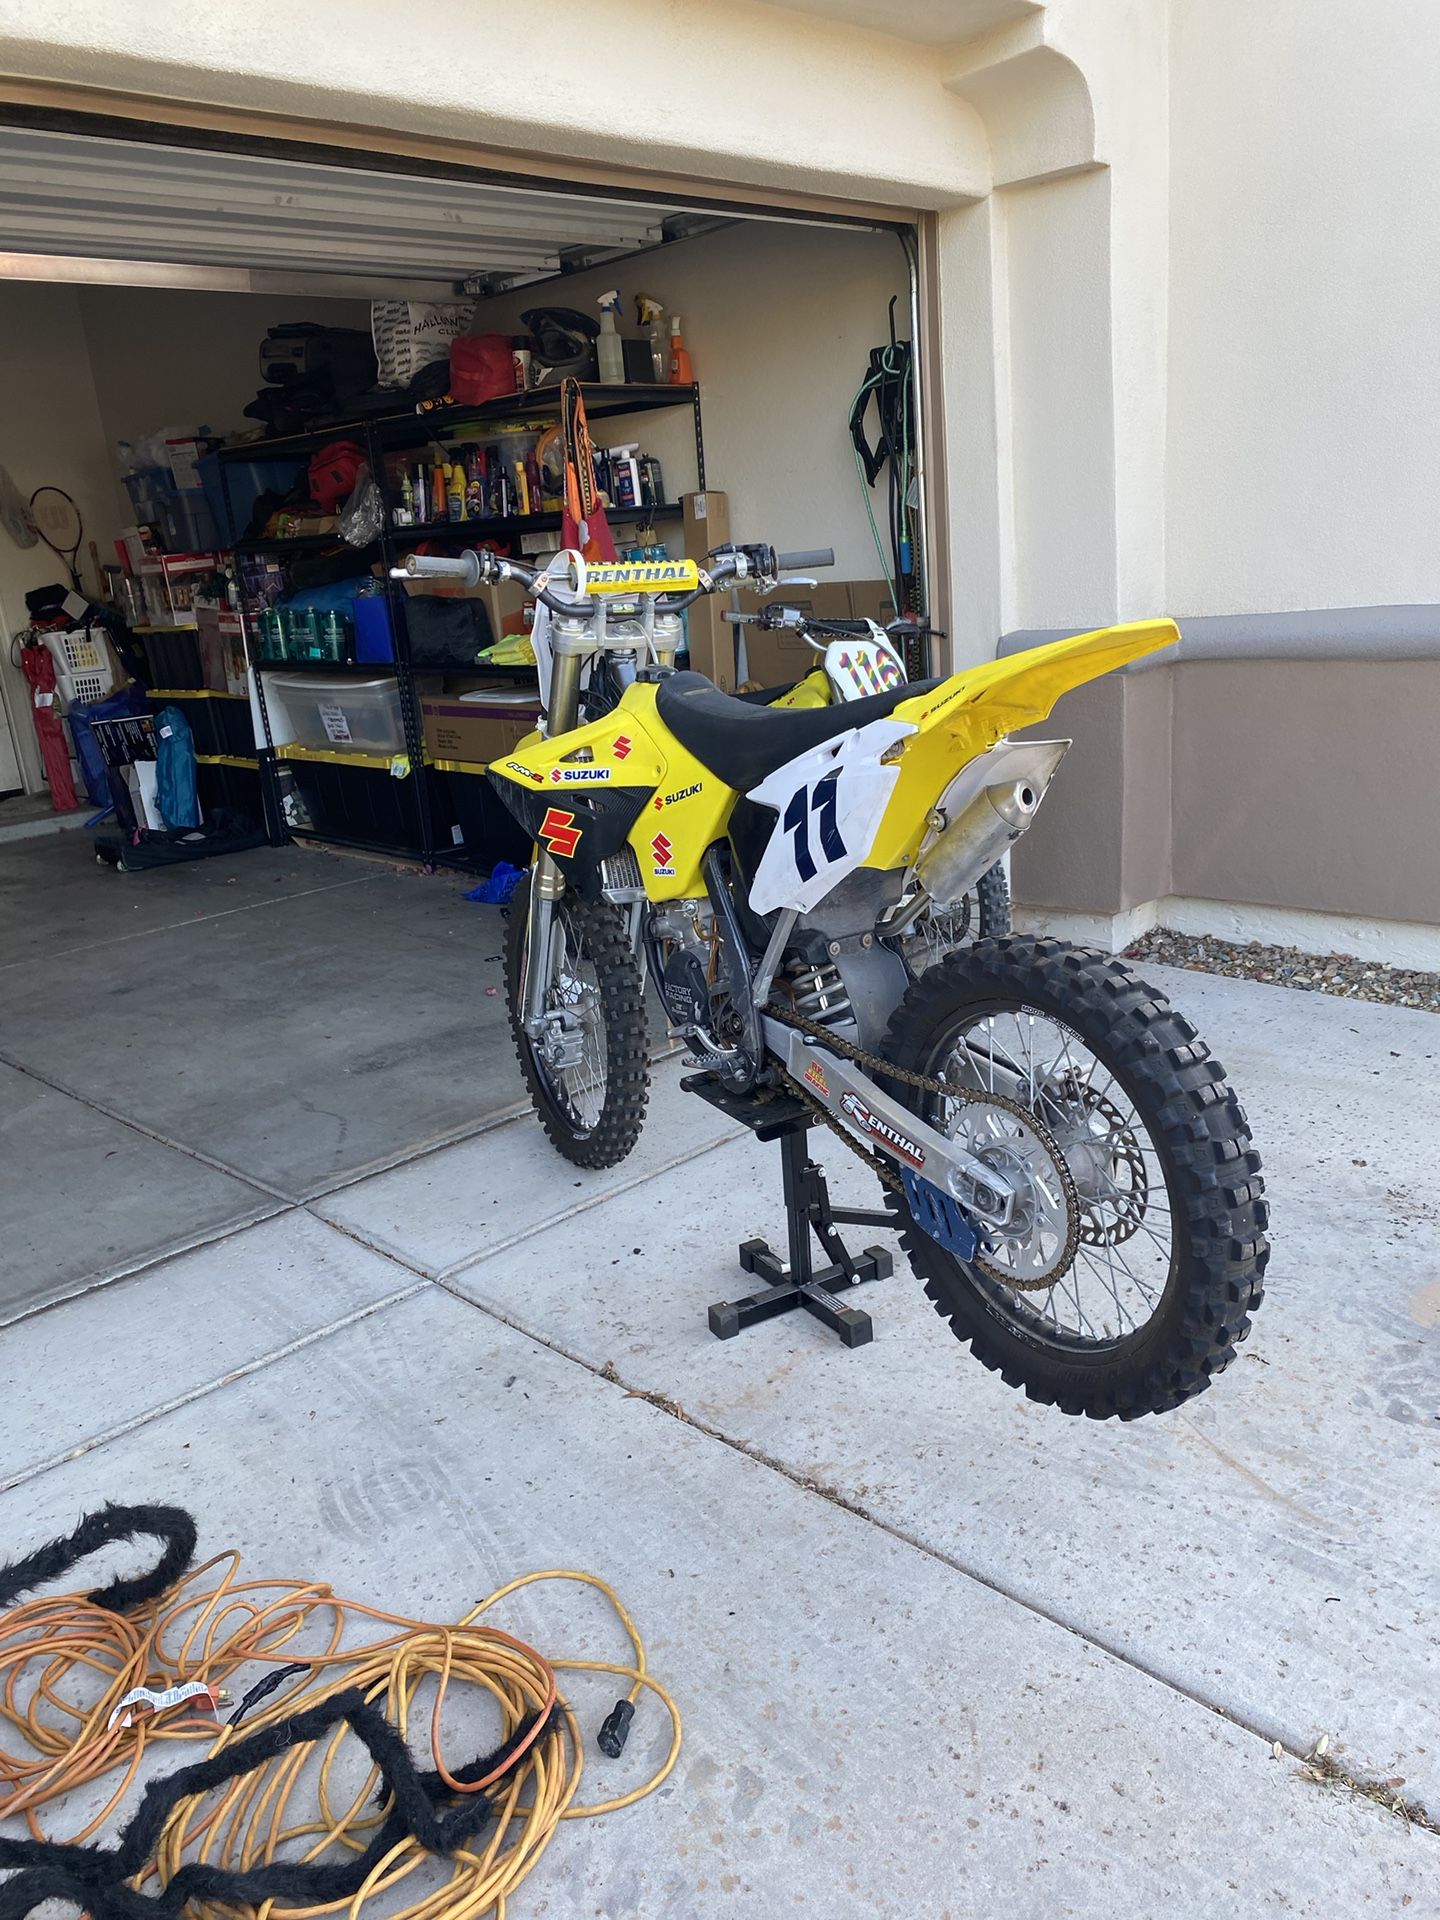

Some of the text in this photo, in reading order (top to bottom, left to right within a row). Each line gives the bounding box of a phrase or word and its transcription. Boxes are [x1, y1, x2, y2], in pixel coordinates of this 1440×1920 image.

[586, 566, 691, 583] RENTHAL
[839, 648, 905, 696] 116
[564, 770, 610, 781] SUZUKI
[665, 782, 703, 806] SUZUKI
[783, 765, 848, 883] 11
[653, 868, 675, 876] SUZUKI
[665, 990, 693, 1004] RACING
[1056, 1019, 1085, 1043] RACING
